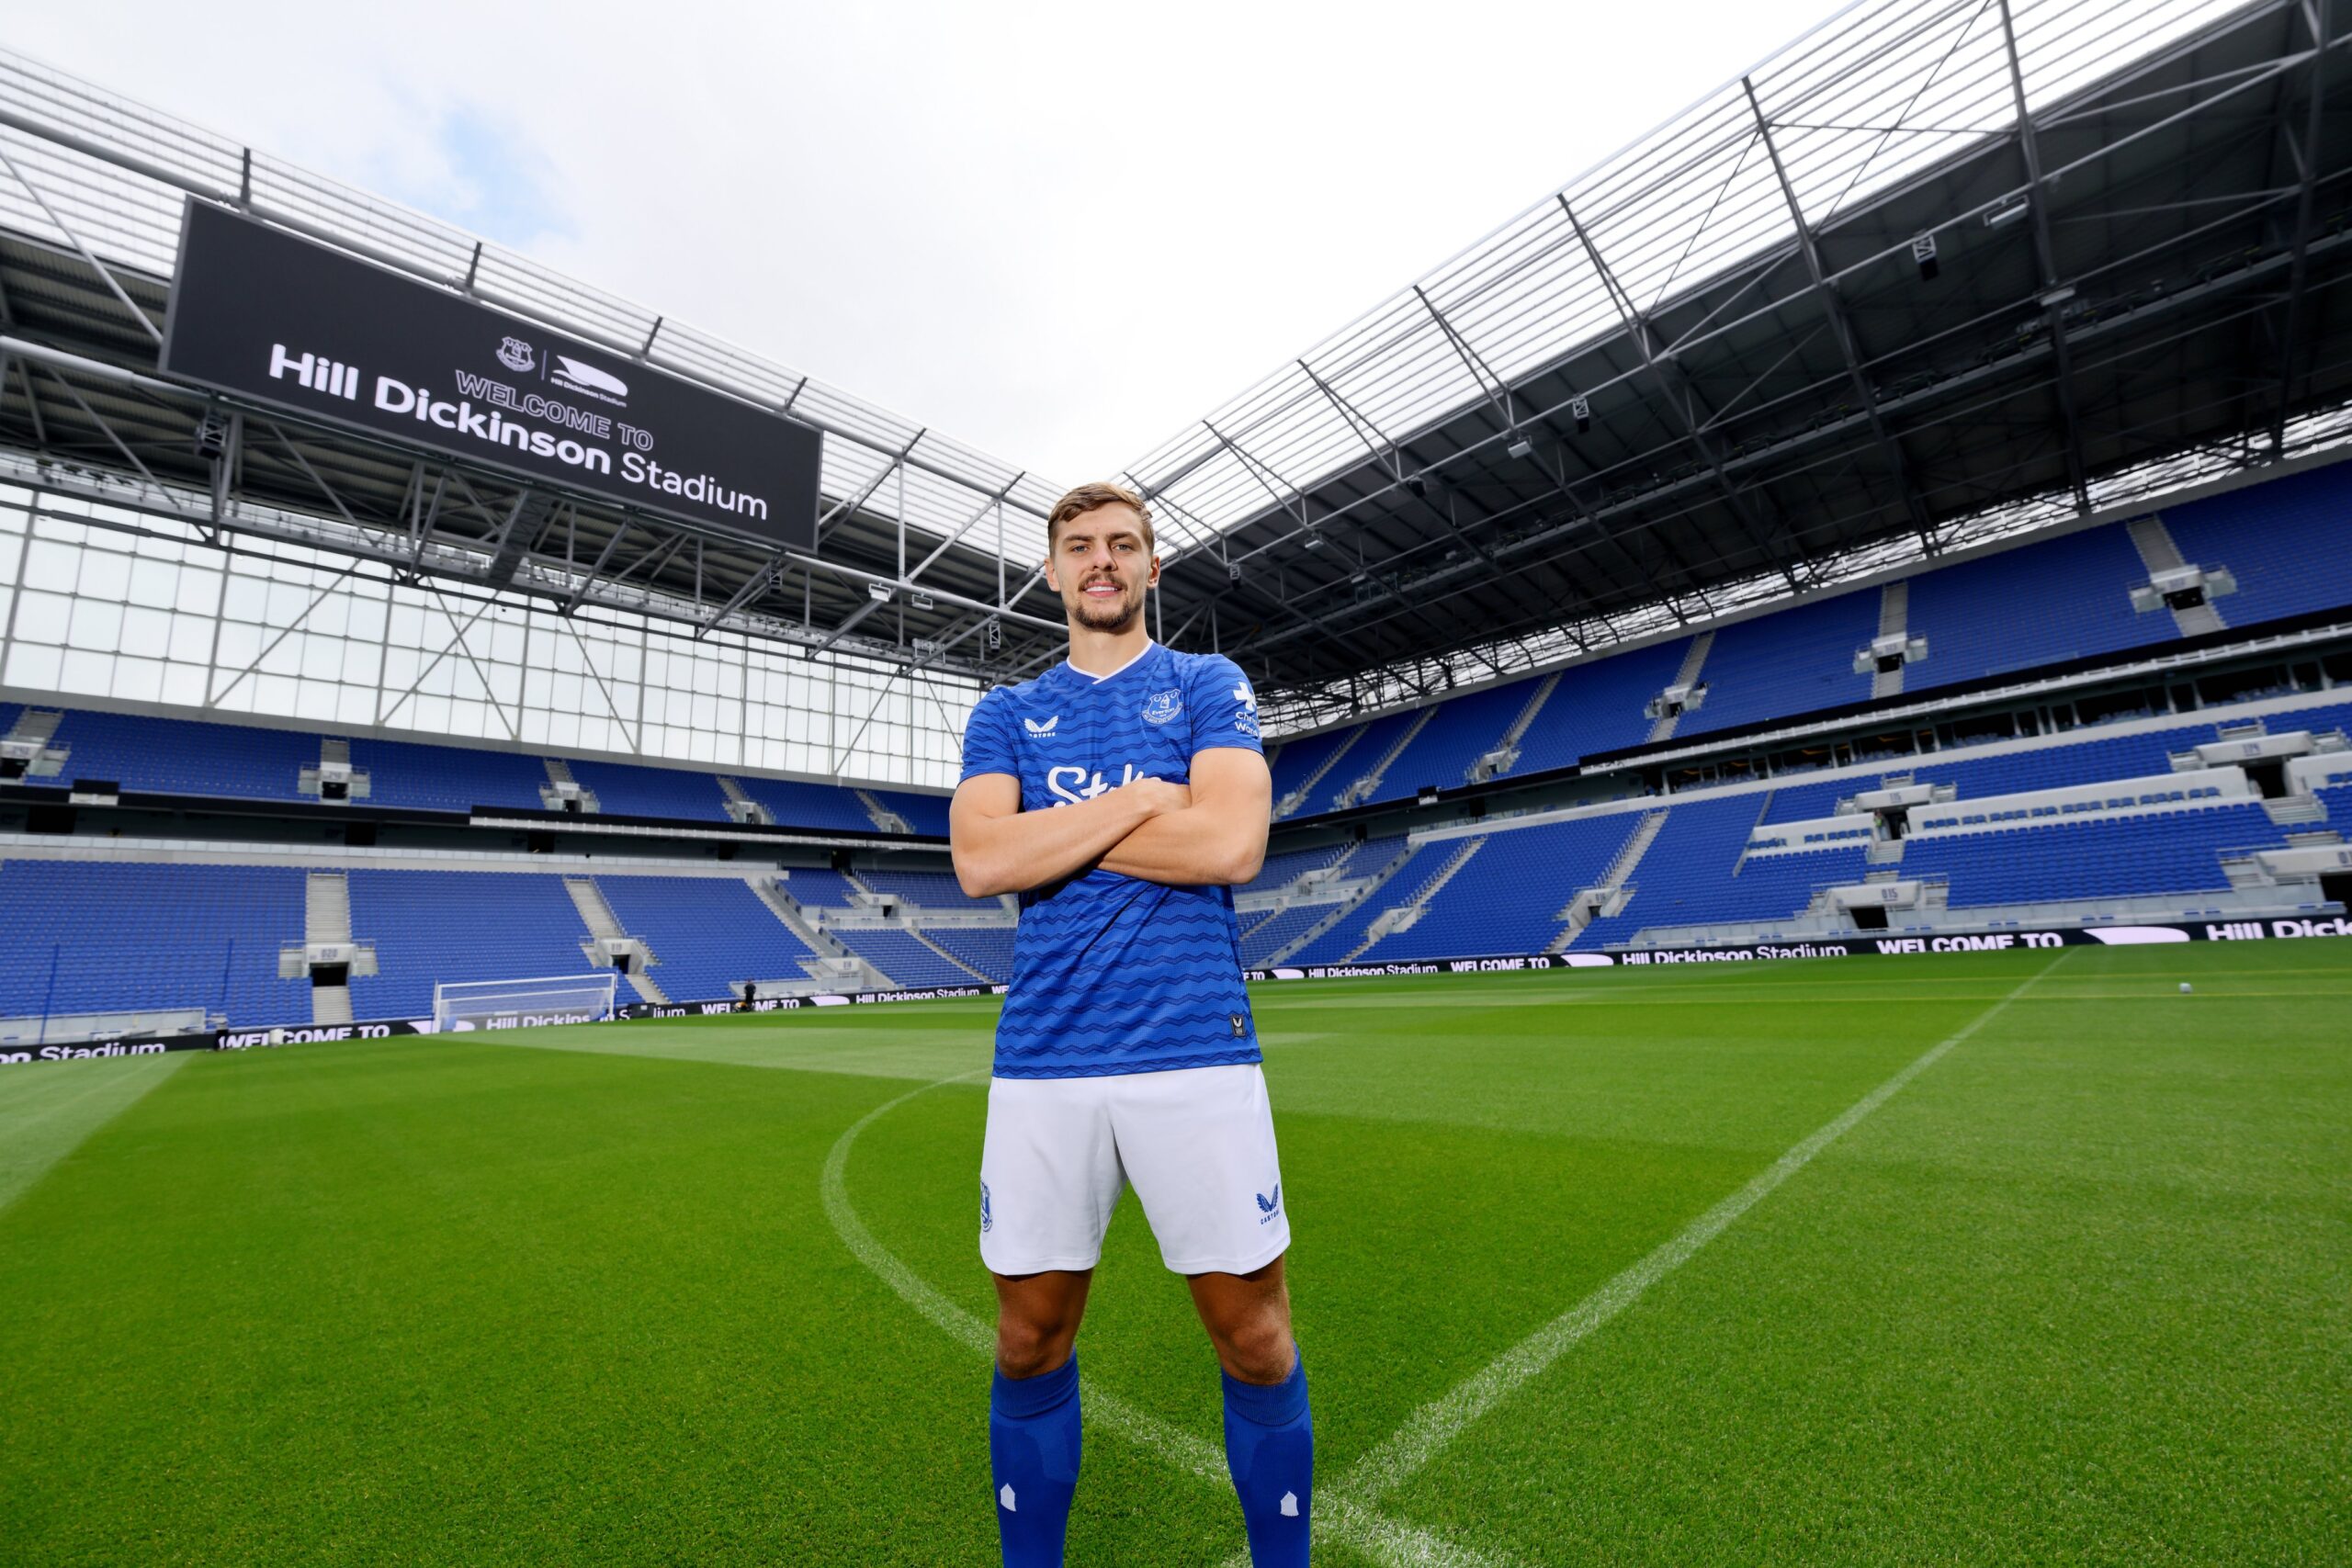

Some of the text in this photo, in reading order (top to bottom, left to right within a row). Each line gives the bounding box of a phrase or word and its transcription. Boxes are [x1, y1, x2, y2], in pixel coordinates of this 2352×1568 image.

[455, 369, 653, 451] WELCOME TO
[269, 344, 767, 520] Hill Dickinson Stadium
[1047, 763, 1162, 808] Stk
[2206, 922, 2265, 941] Hill
[1876, 932, 2064, 954] WELCOME TO
[1622, 943, 1848, 965] Hill Dickinson Stadium
[1308, 964, 1438, 978] Hill Dickinson Stadium
[1451, 957, 1550, 973] WELCOME TO
[1250, 971, 1265, 981] TO
[780, 998, 800, 1010] TO
[856, 994, 875, 1004] Hill
[877, 992, 934, 1003] Dickinson
[936, 988, 979, 998] Stadium
[357, 1024, 390, 1039] TO
[486, 1016, 517, 1031] Hill
[40, 1042, 165, 1062] Stadium
